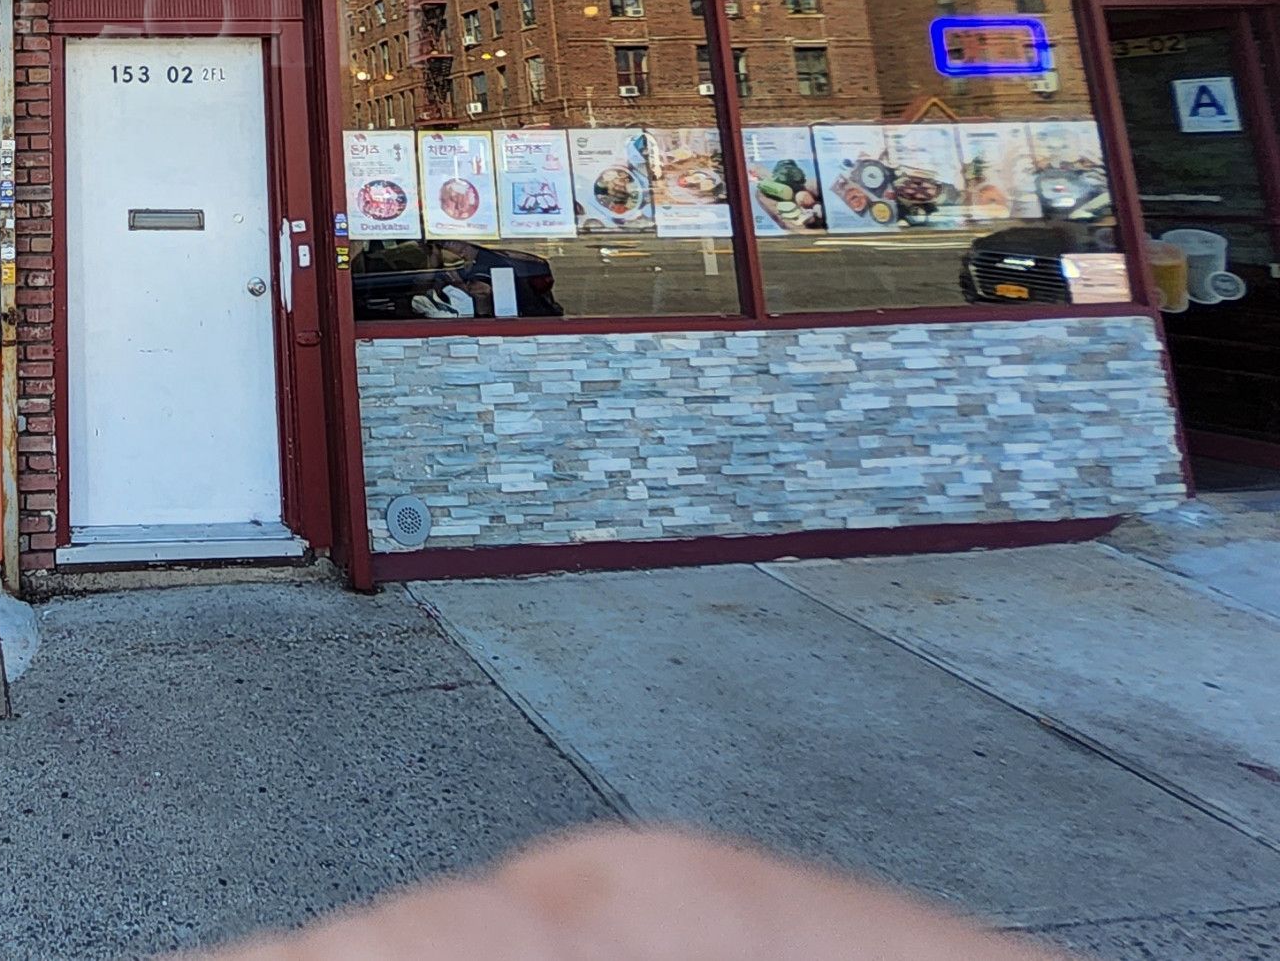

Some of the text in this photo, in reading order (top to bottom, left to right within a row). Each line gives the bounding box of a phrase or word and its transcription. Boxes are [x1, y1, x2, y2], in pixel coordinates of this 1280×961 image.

[111, 65, 150, 83] 153
[166, 66, 193, 83] 02
[1188, 84, 1228, 118] A
